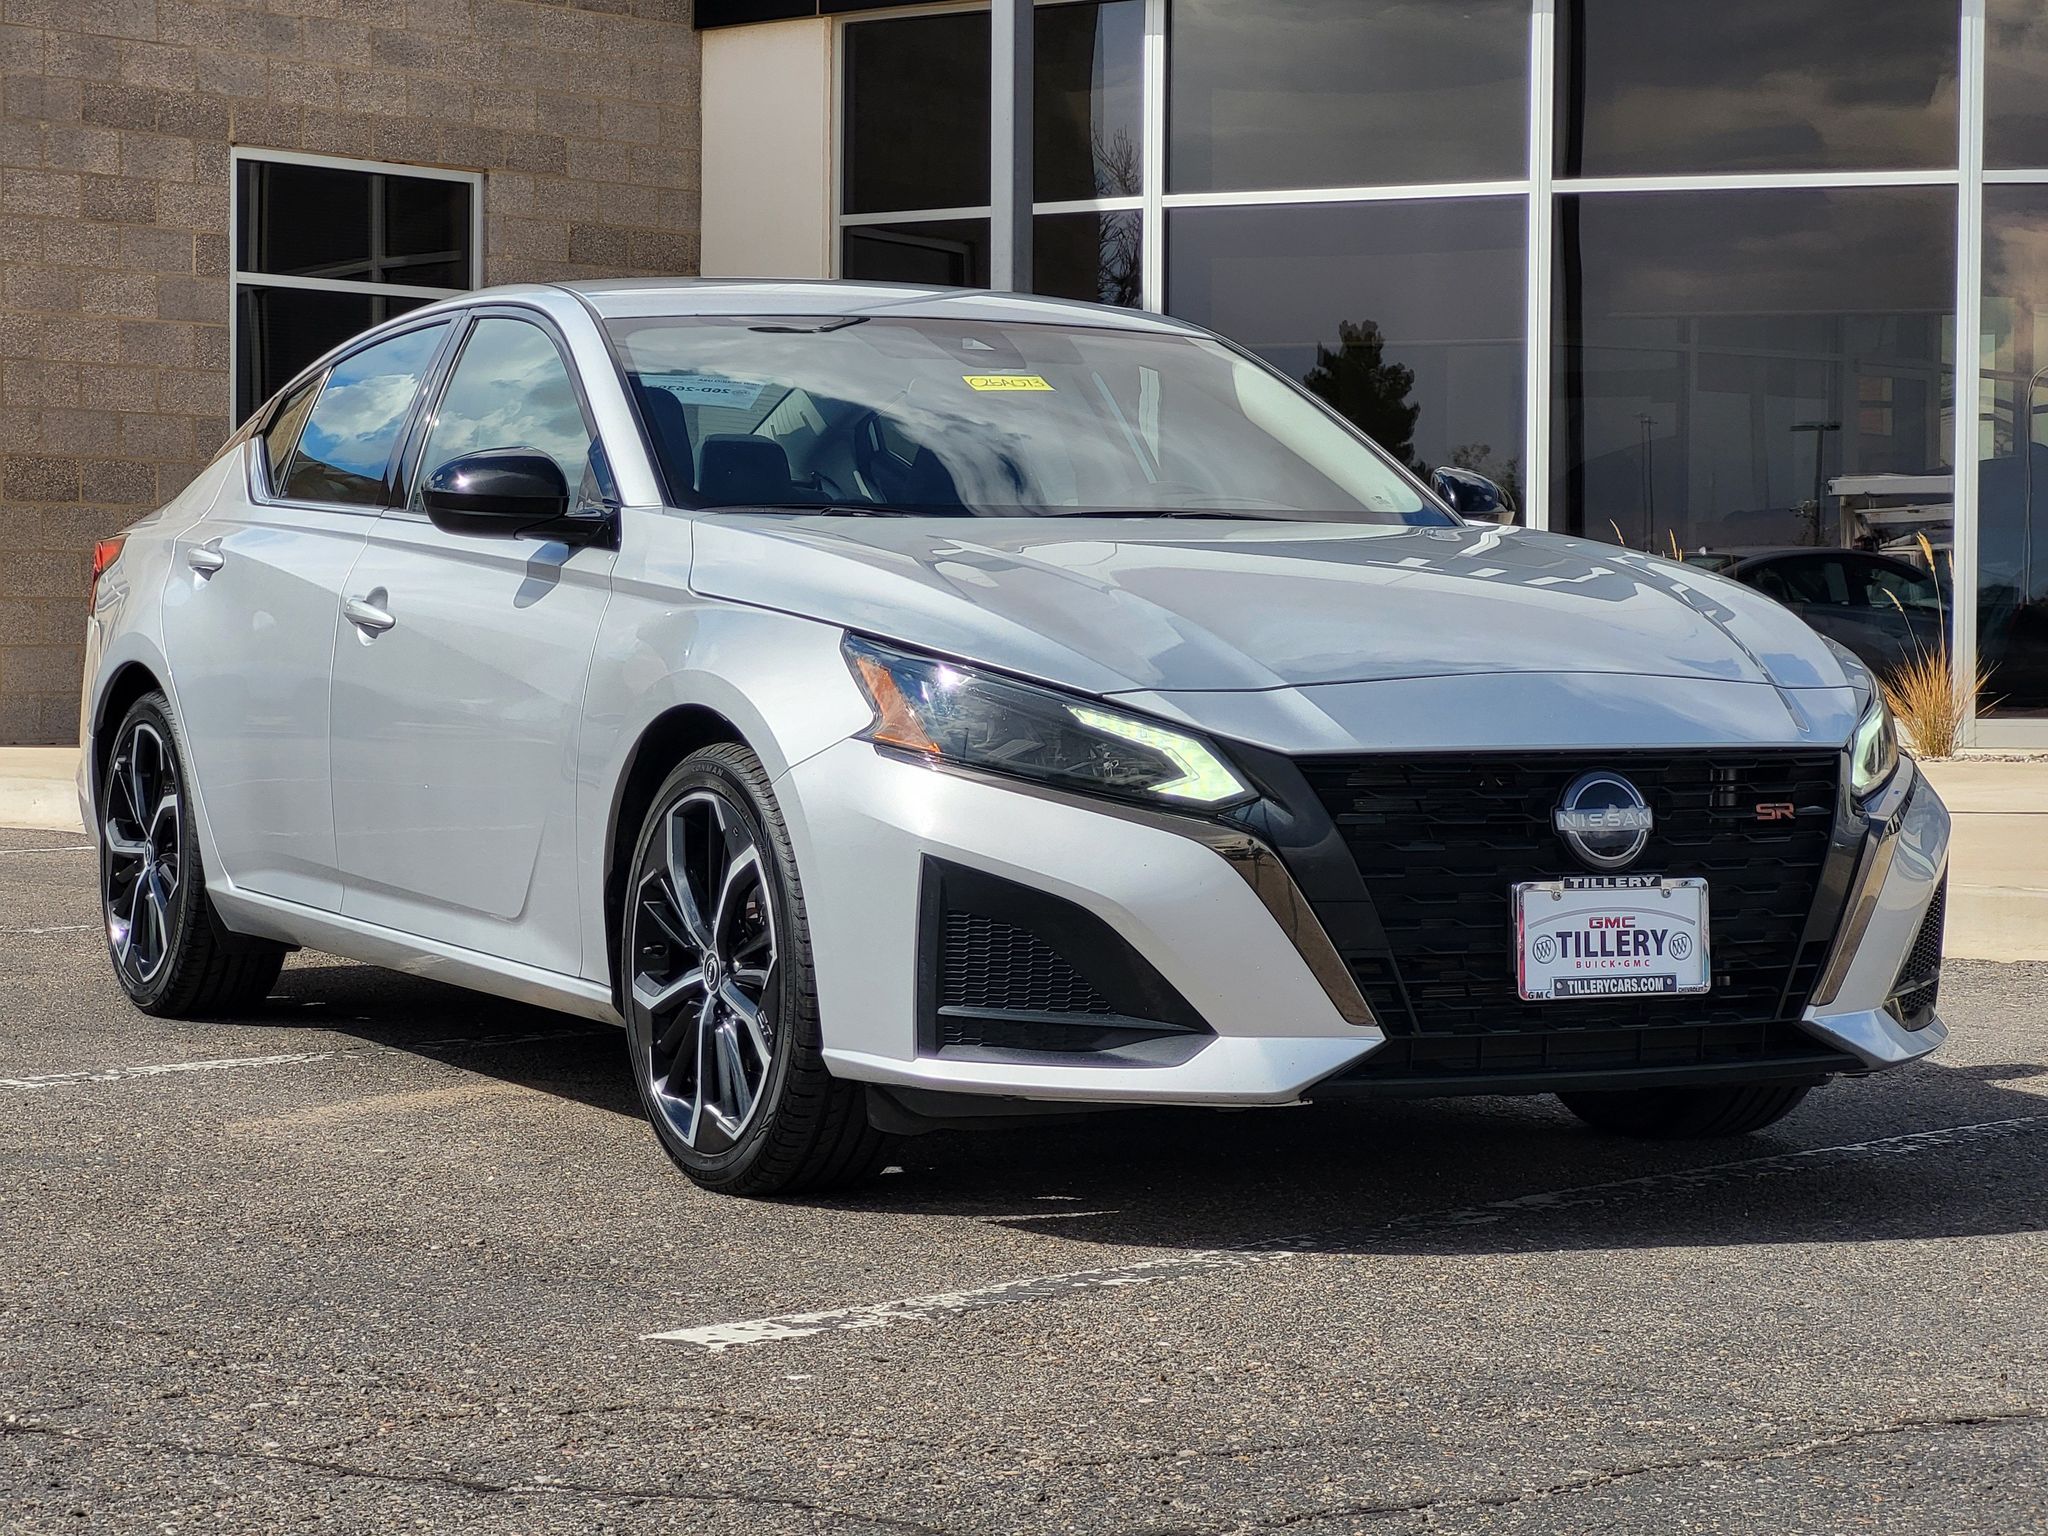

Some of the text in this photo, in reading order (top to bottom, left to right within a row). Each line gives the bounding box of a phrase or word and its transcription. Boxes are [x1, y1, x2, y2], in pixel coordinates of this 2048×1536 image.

[1559, 811, 1651, 828] NISSAN
[1755, 803, 1796, 820] SR
[1569, 876, 1656, 889] TILLERY
[1589, 916, 1636, 929] GMC
[1556, 929, 1669, 959] TILLERY
[1567, 977, 1664, 995] TILLERYCARS.COM
[1527, 991, 1551, 999] GMC
